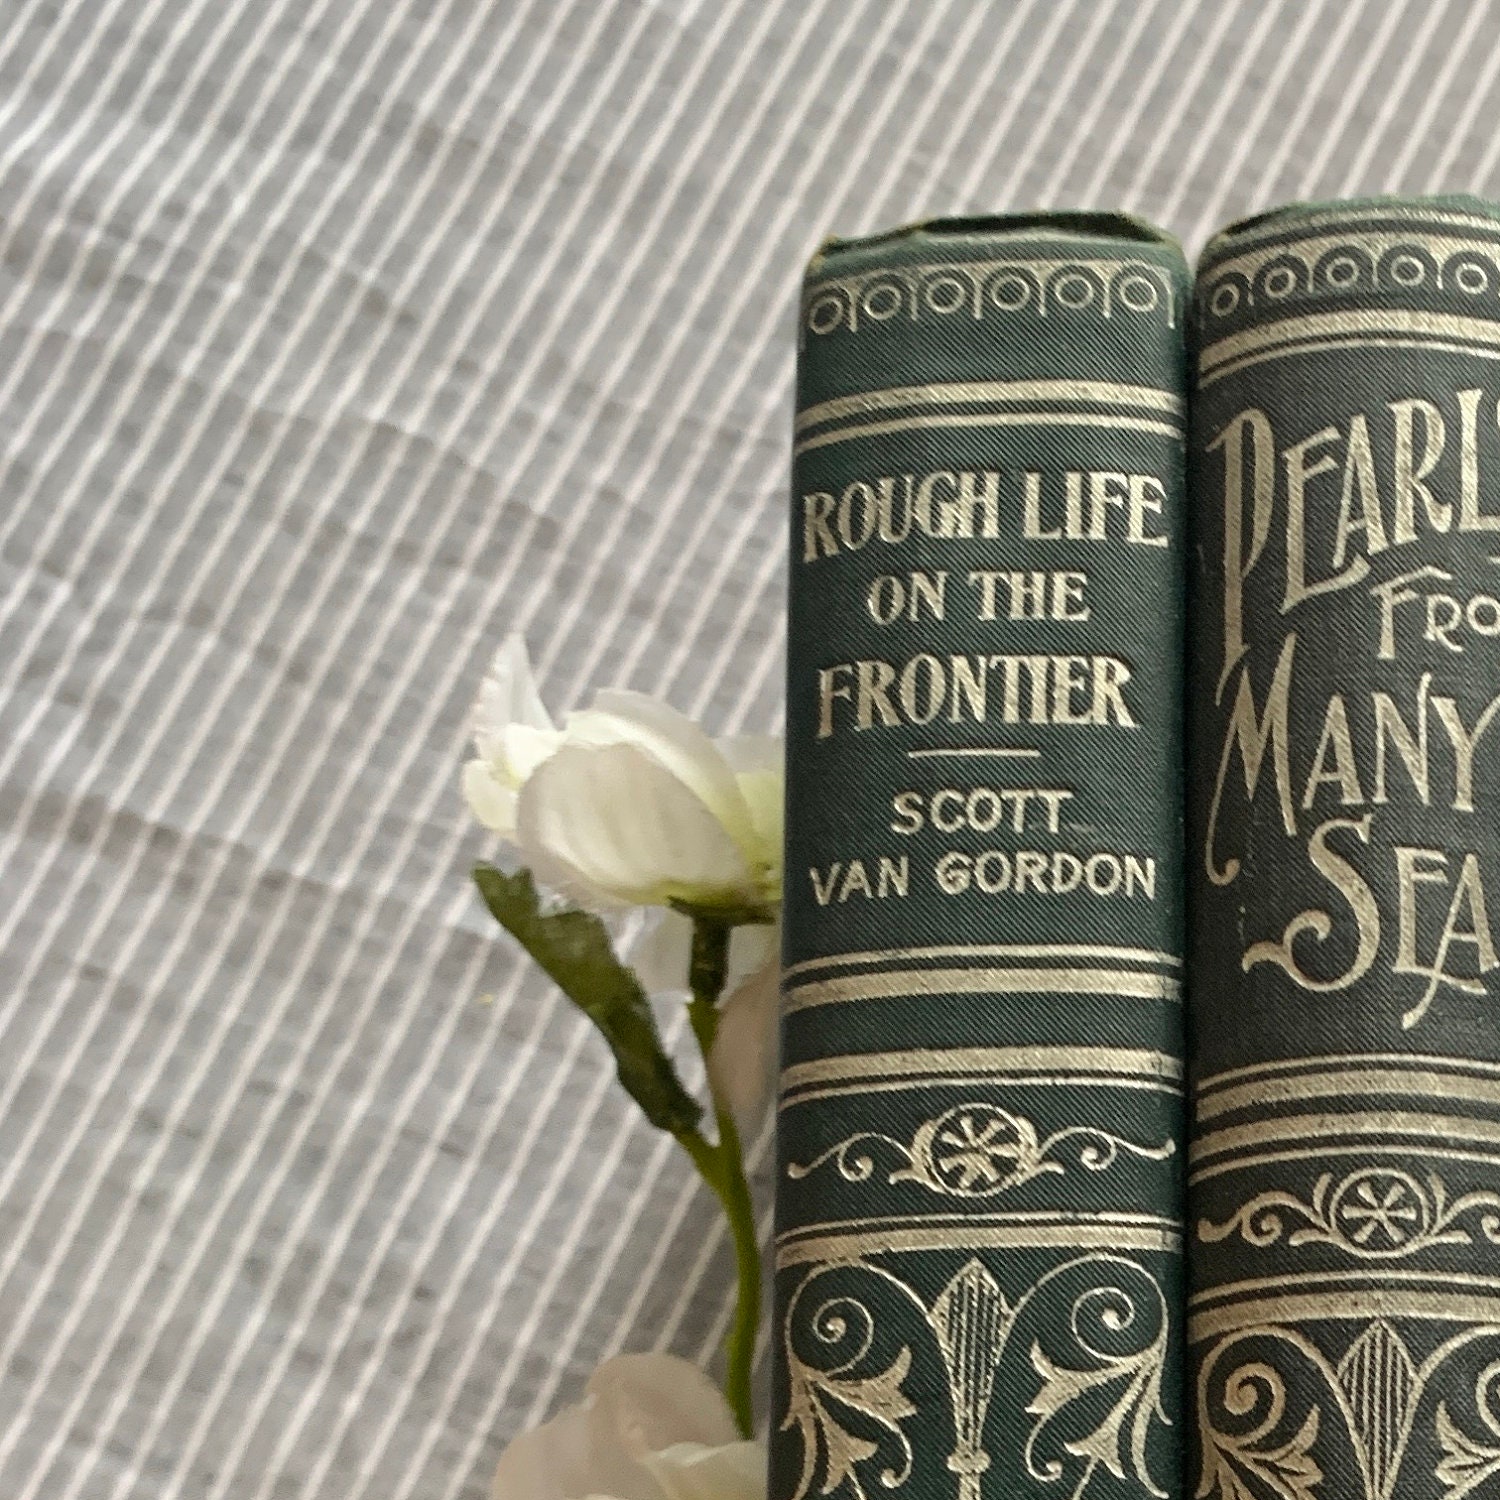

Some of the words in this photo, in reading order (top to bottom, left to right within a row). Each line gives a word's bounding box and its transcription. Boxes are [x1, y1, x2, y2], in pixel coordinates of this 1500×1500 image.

[803, 469, 1001, 564] ROUGH
[1022, 471, 1170, 548] LIFE
[866, 569, 948, 626] ON
[968, 570, 1092, 622] THE
[815, 652, 1141, 740] FRONTIER
[891, 788, 1074, 834] SCOTT
[808, 855, 910, 907] VAN
[933, 850, 1157, 901] GORDON
